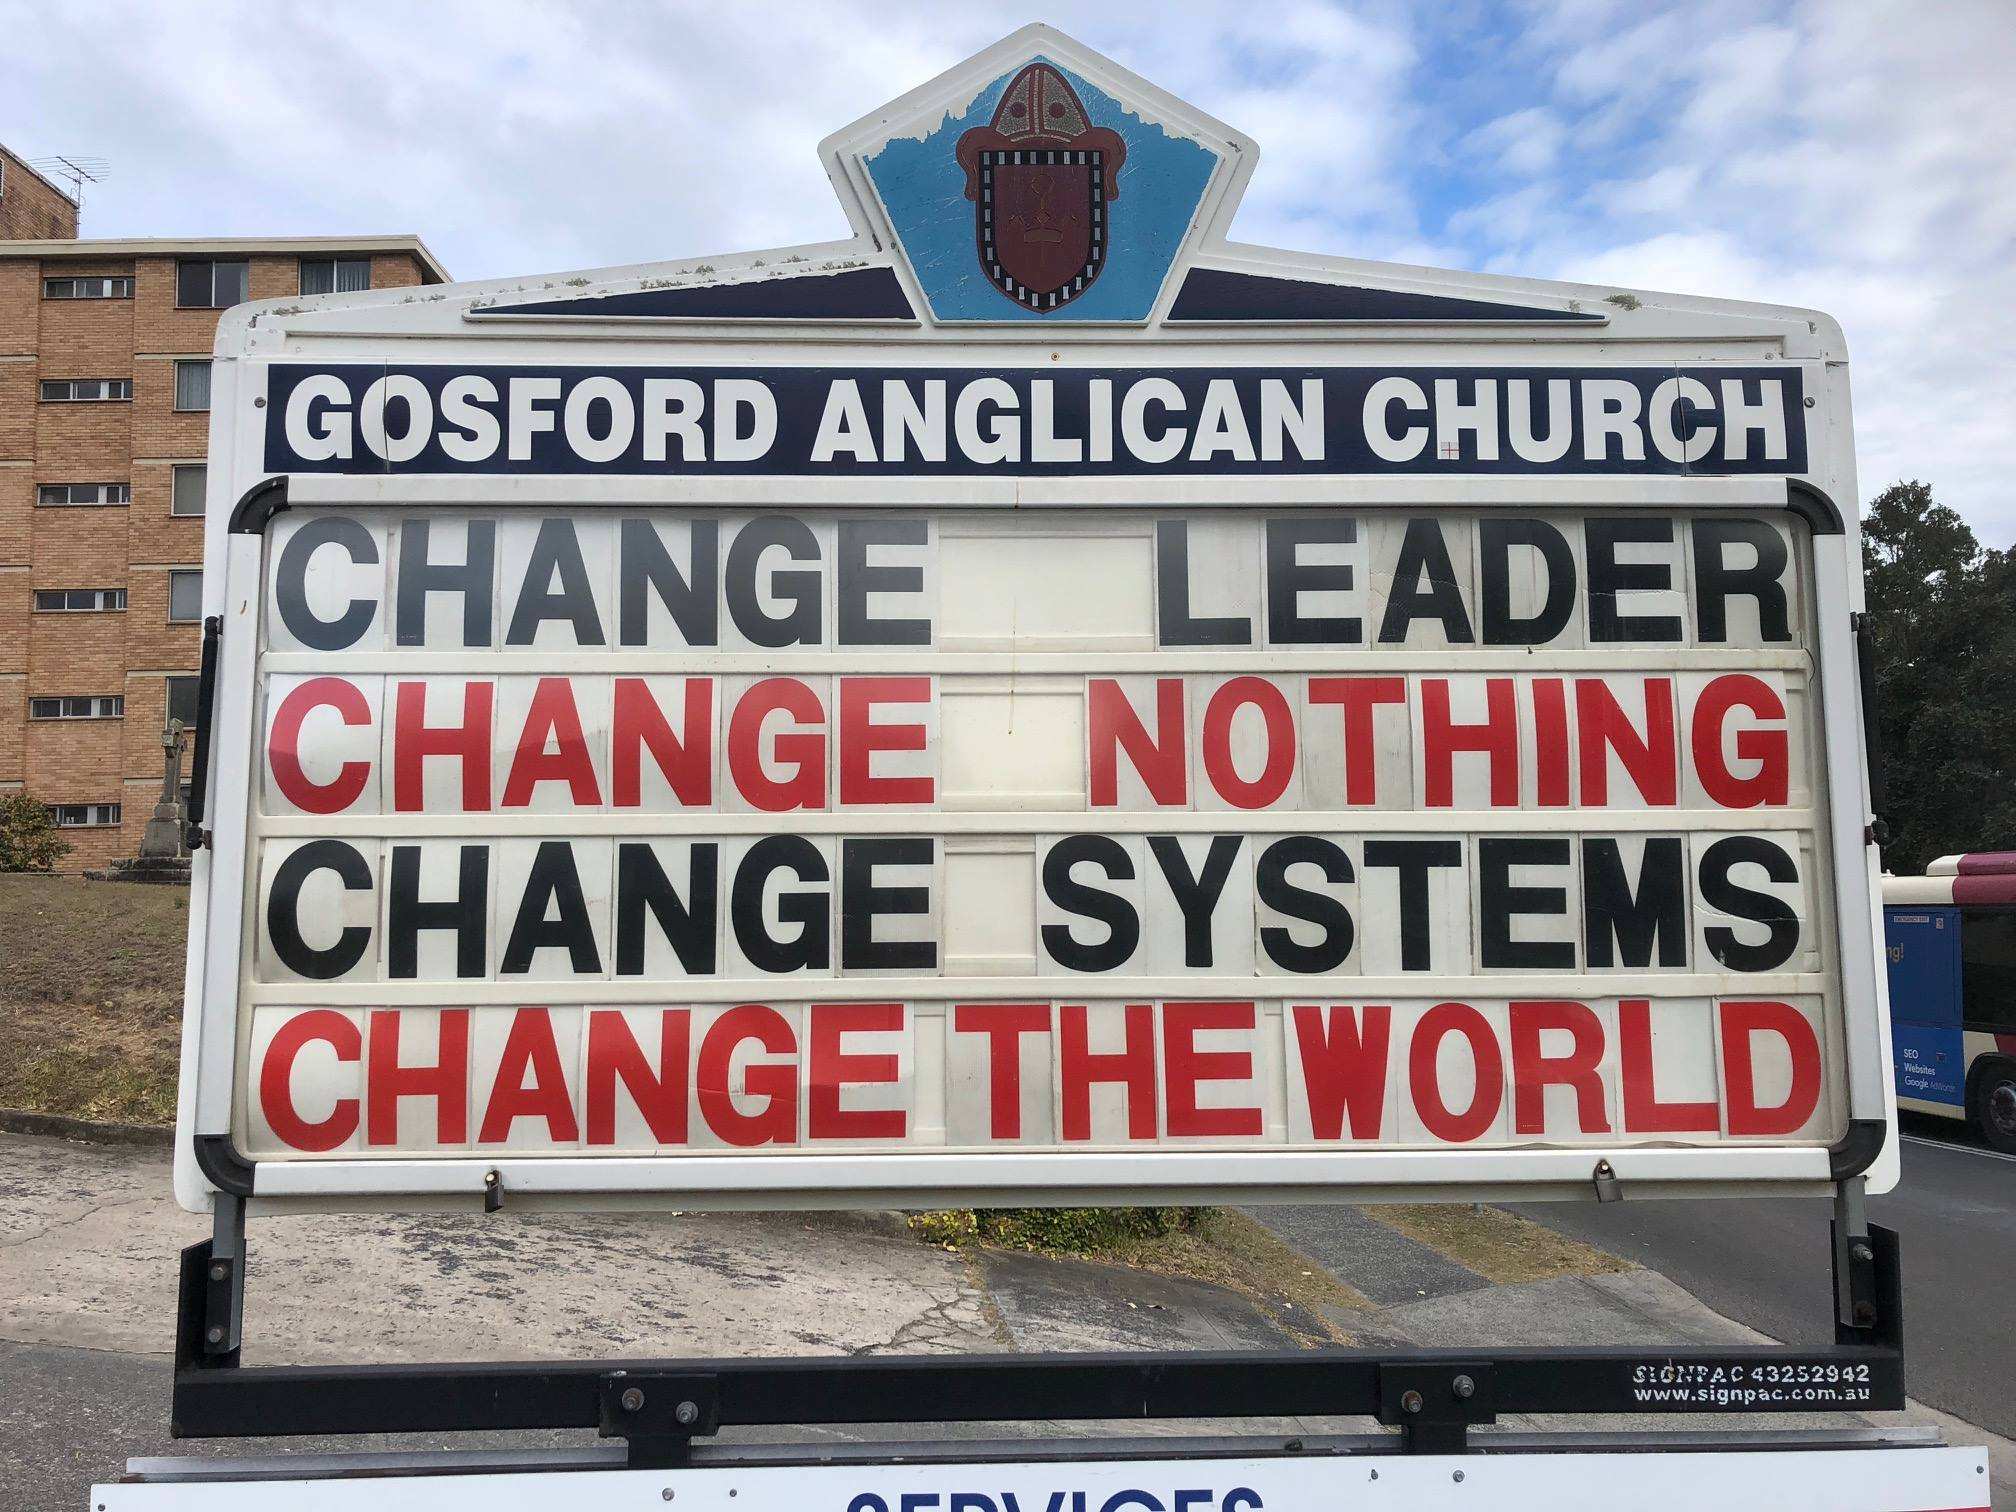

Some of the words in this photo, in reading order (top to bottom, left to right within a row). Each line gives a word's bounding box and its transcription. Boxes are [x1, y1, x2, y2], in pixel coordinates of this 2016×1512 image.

[284, 374, 777, 462] GOSFORD
[811, 376, 1326, 463] ANGLICAN
[1363, 377, 1788, 463] CHURCH
[275, 516, 932, 651] CHANGE
[1157, 517, 1793, 646] LEADER
[269, 676, 935, 814] CHANGE
[1089, 674, 1789, 809] NOTHING
[267, 835, 937, 979] CHANGE
[1041, 834, 1800, 973] SYSTEMS
[260, 1003, 906, 1152] CHANGE
[954, 1001, 1263, 1140] THE
[1293, 999, 1822, 1143] WORLD
[1903, 1048, 1919, 1059] SEO
[1904, 1062, 1936, 1075] Websites
[1904, 1075, 1929, 1090] Google
[1633, 1365, 1744, 1383] SIGNPAC
[1751, 1364, 1869, 1382] 43252942
[1634, 1385, 1870, 1404] www.signpac.com.au
